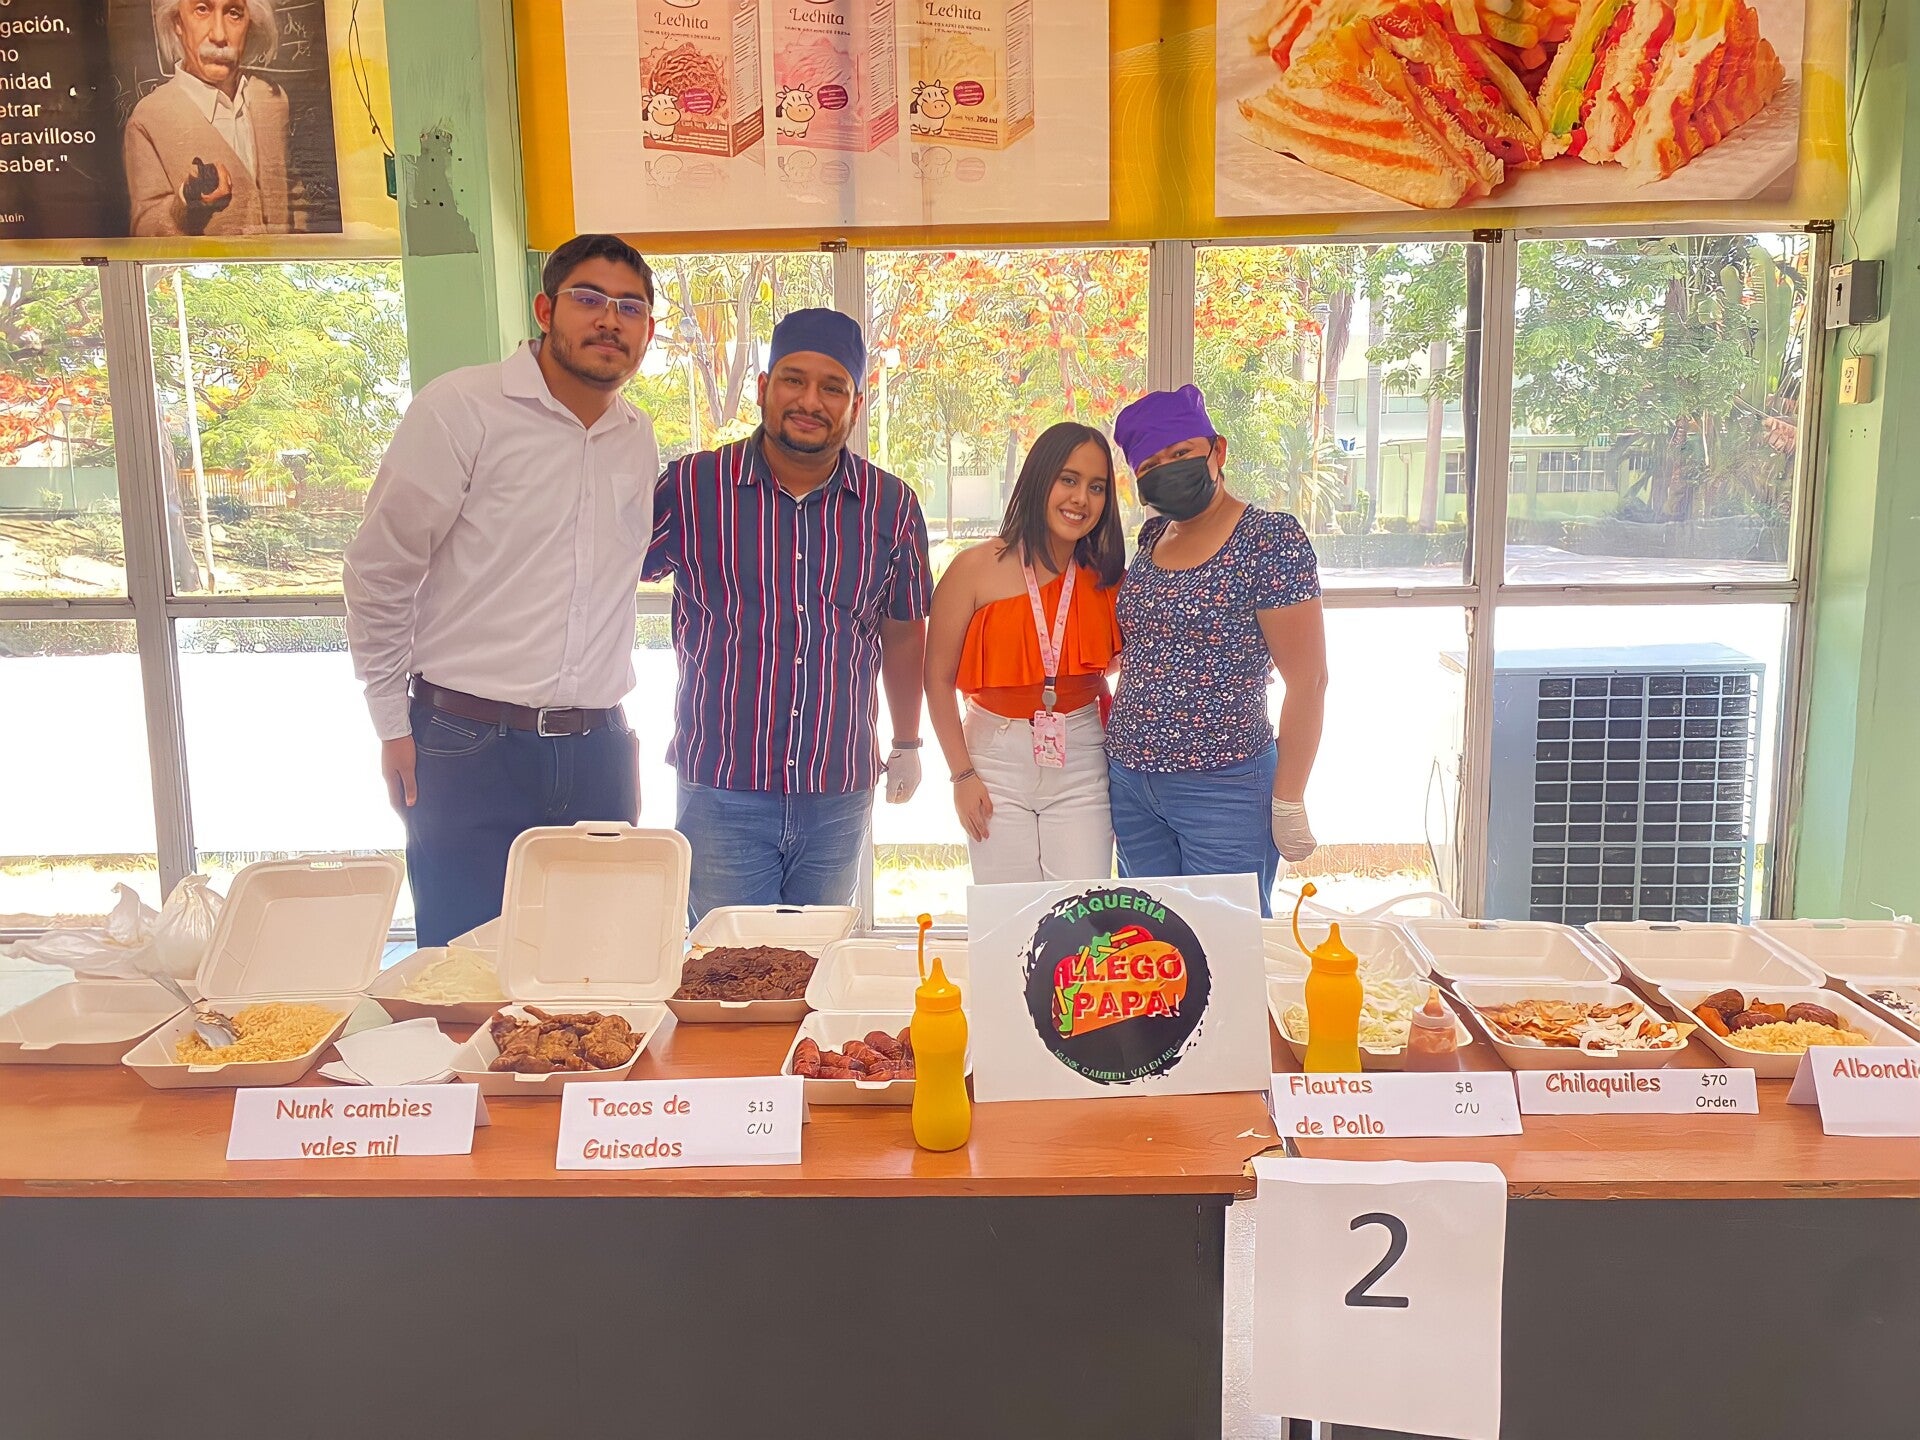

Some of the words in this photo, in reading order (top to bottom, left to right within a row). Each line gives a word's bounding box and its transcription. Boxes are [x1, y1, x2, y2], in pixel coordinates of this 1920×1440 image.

[653, 11, 709, 29] Lechita
[789, 8, 845, 25] Lechita
[925, 2, 982, 20] Lechita
[0, 15, 71, 38] gación,
[1, 127, 96, 145] aravilloso
[1063, 894, 1167, 924] TAQUERIA
[1832, 1057, 1920, 1079] Albondi
[1289, 1076, 1373, 1096] Flautas
[1455, 1082, 1473, 1094] $8
[1546, 1072, 1661, 1098] Chilaquiles
[1701, 1074, 1728, 1087] $70
[276, 1098, 334, 1120] Nunk
[343, 1097, 433, 1119] cambies
[588, 1097, 653, 1117] Tacos
[663, 1095, 691, 1115] de
[748, 1101, 774, 1113] $13
[1454, 1103, 1480, 1115] C/U
[1696, 1096, 1737, 1109] Orden
[747, 1123, 773, 1135] C/U
[1296, 1115, 1324, 1135] de
[1333, 1115, 1386, 1135] Pollo
[301, 1136, 357, 1157] vales
[367, 1134, 399, 1157] mil
[583, 1137, 683, 1160] Guisados
[1345, 1212, 1409, 1308] 2
